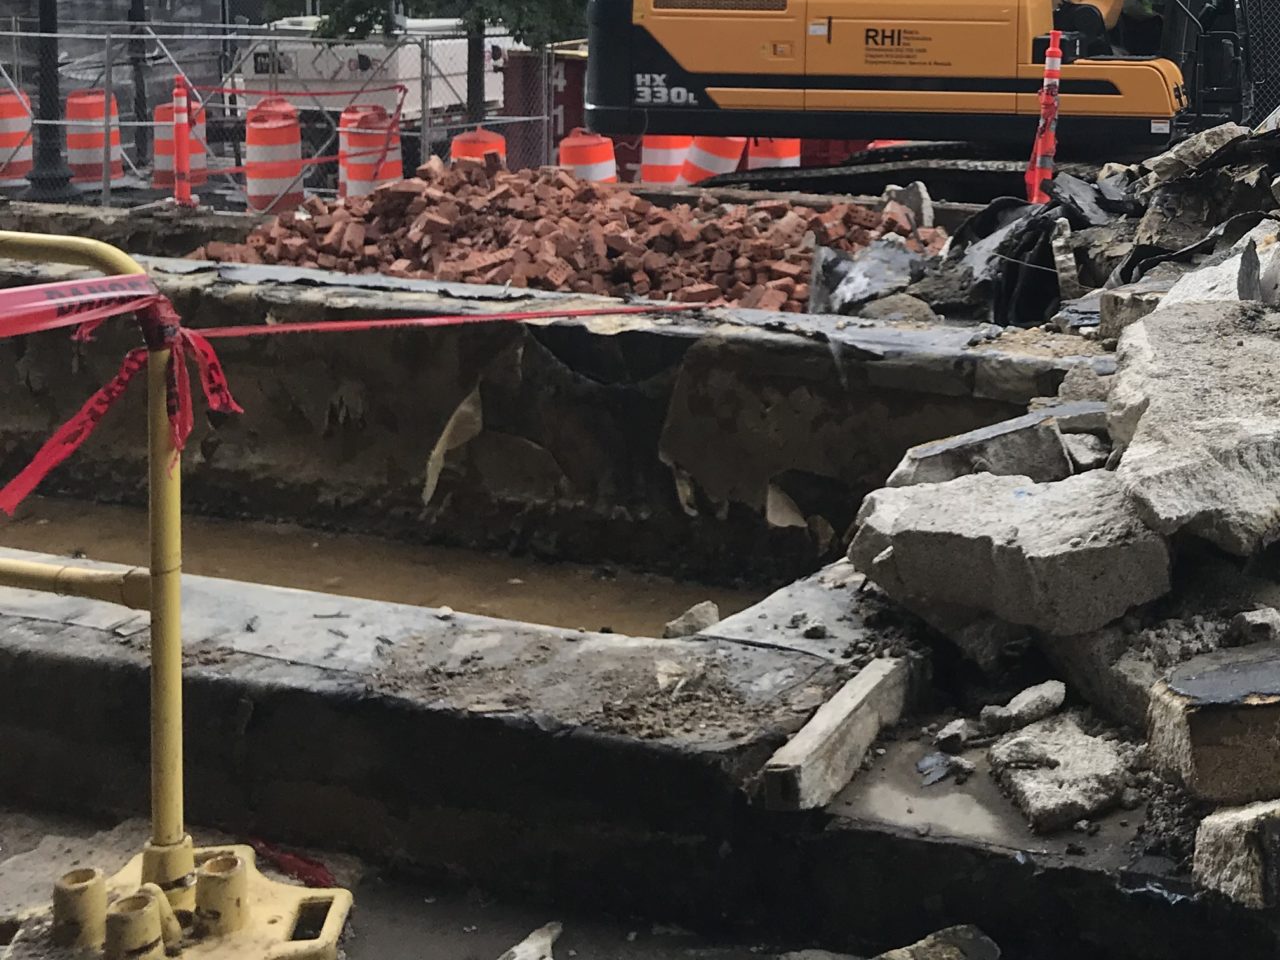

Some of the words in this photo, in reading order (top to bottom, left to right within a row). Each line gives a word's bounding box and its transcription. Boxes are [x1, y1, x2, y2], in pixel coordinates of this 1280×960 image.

[865, 28, 901, 46] RHI
[635, 73, 667, 86] HX
[635, 87, 698, 104] 330L
